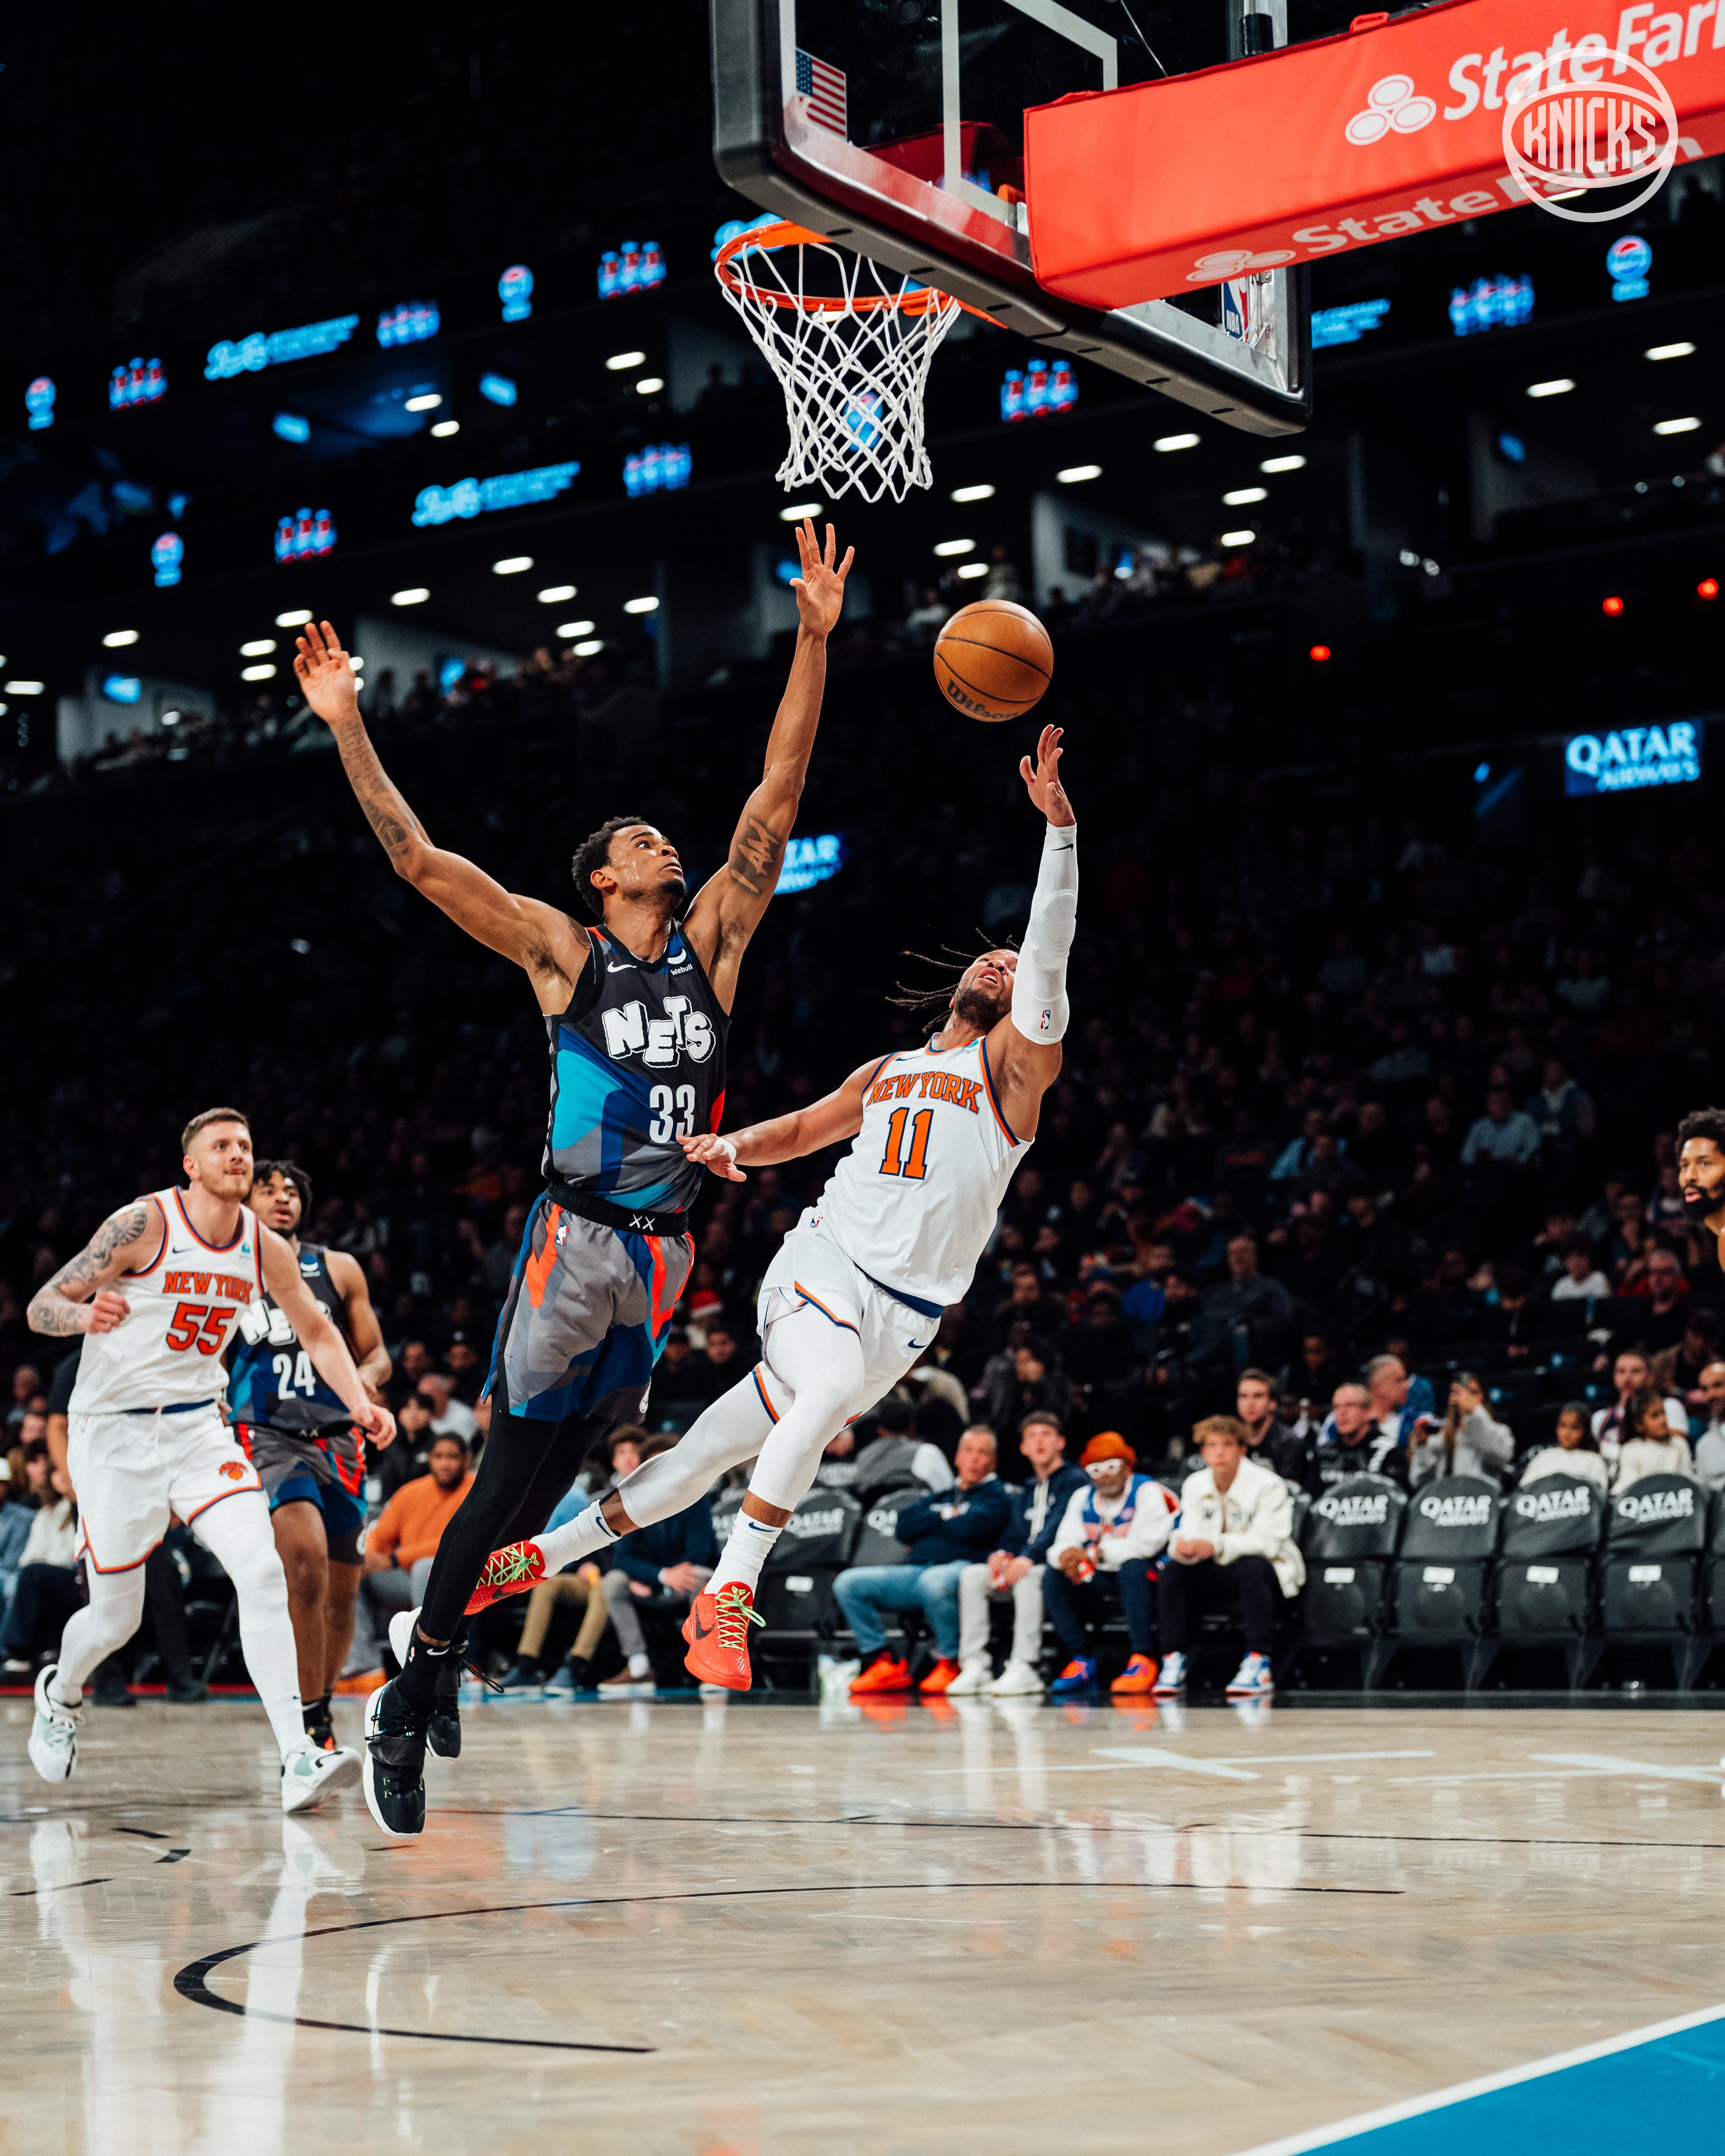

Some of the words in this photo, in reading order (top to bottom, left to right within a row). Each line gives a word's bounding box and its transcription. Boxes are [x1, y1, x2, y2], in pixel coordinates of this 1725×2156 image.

[1443, 28, 1607, 120] State
[1292, 190, 1499, 252] State
[1226, 309, 1240, 335] NBA
[1566, 722, 1698, 777] QATAR
[670, 963, 693, 975] Webull
[602, 995, 716, 1068] NETS
[649, 1084, 695, 1143] 33
[865, 1073, 920, 1107] NEW
[918, 1071, 983, 1115] YORK
[878, 1107, 934, 1180] 11
[162, 1271, 212, 1294] NEW
[213, 1273, 253, 1306] YORK
[166, 1302, 236, 1355] 55
[273, 1350, 316, 1400] 24
[1319, 1495, 1388, 1520] QATAR
[1421, 1495, 1491, 1519] QATAR
[1516, 1485, 1590, 1518] QATAR
[1618, 1488, 1693, 1519] QATAR
